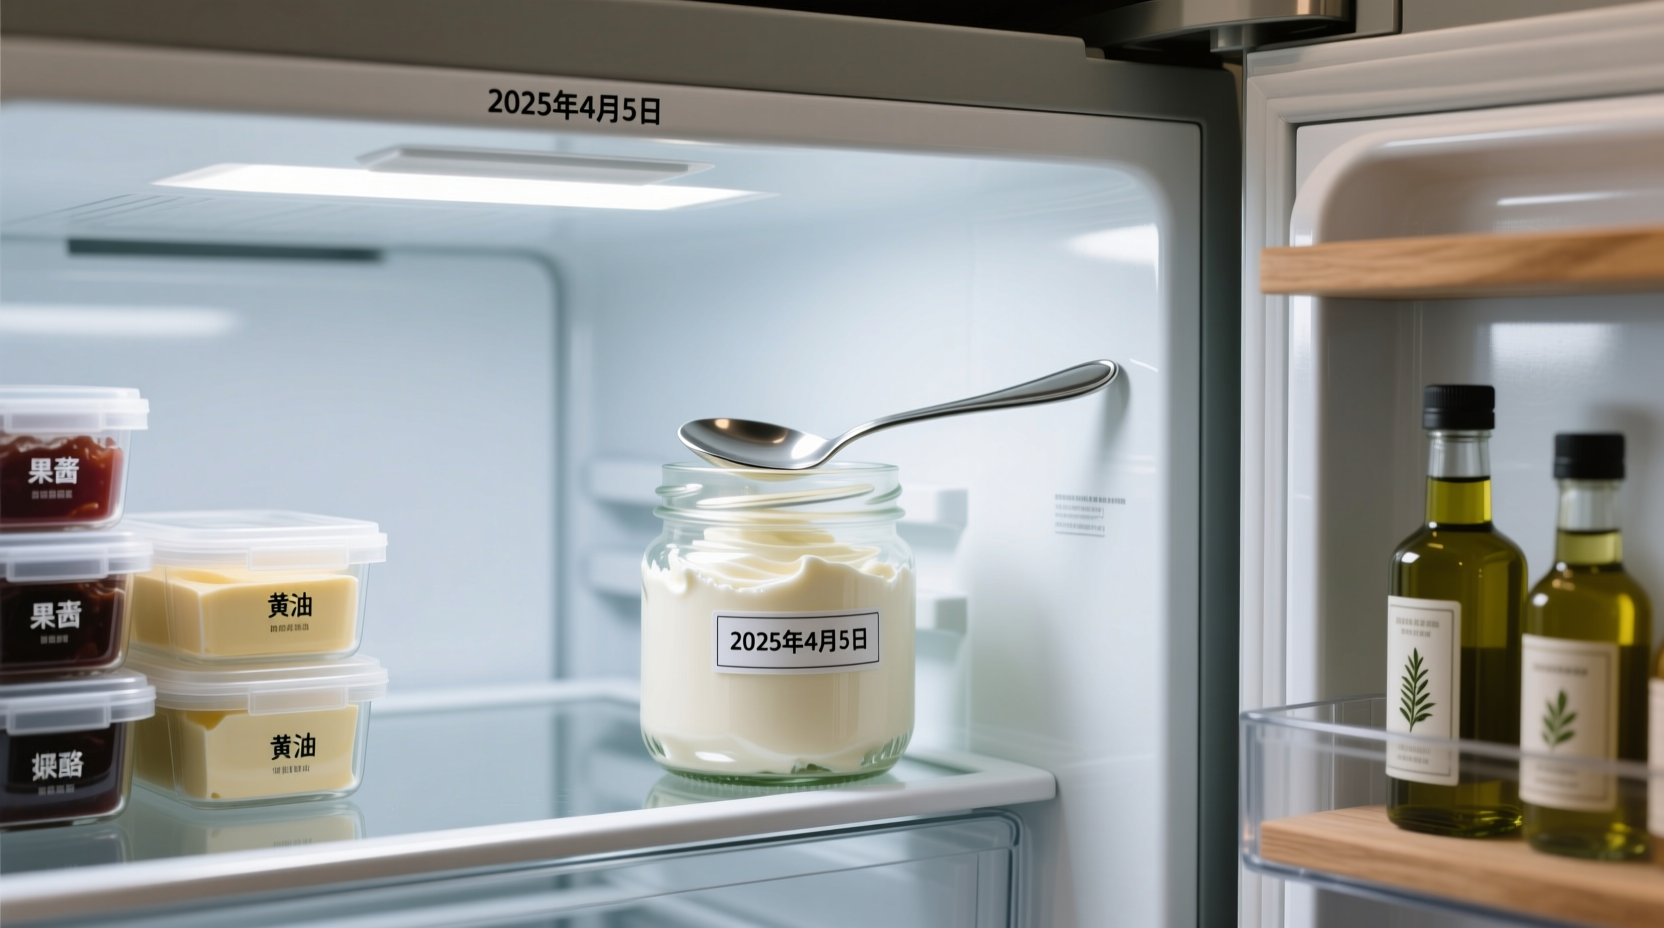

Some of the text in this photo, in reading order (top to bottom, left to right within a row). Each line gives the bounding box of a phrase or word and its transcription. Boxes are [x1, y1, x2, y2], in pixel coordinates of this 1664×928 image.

[488, 88, 660, 125] 2025年4月5日
[267, 592, 312, 618] 黄油
[730, 627, 867, 655] 2025年4月5日
[270, 732, 316, 760] 黄油
